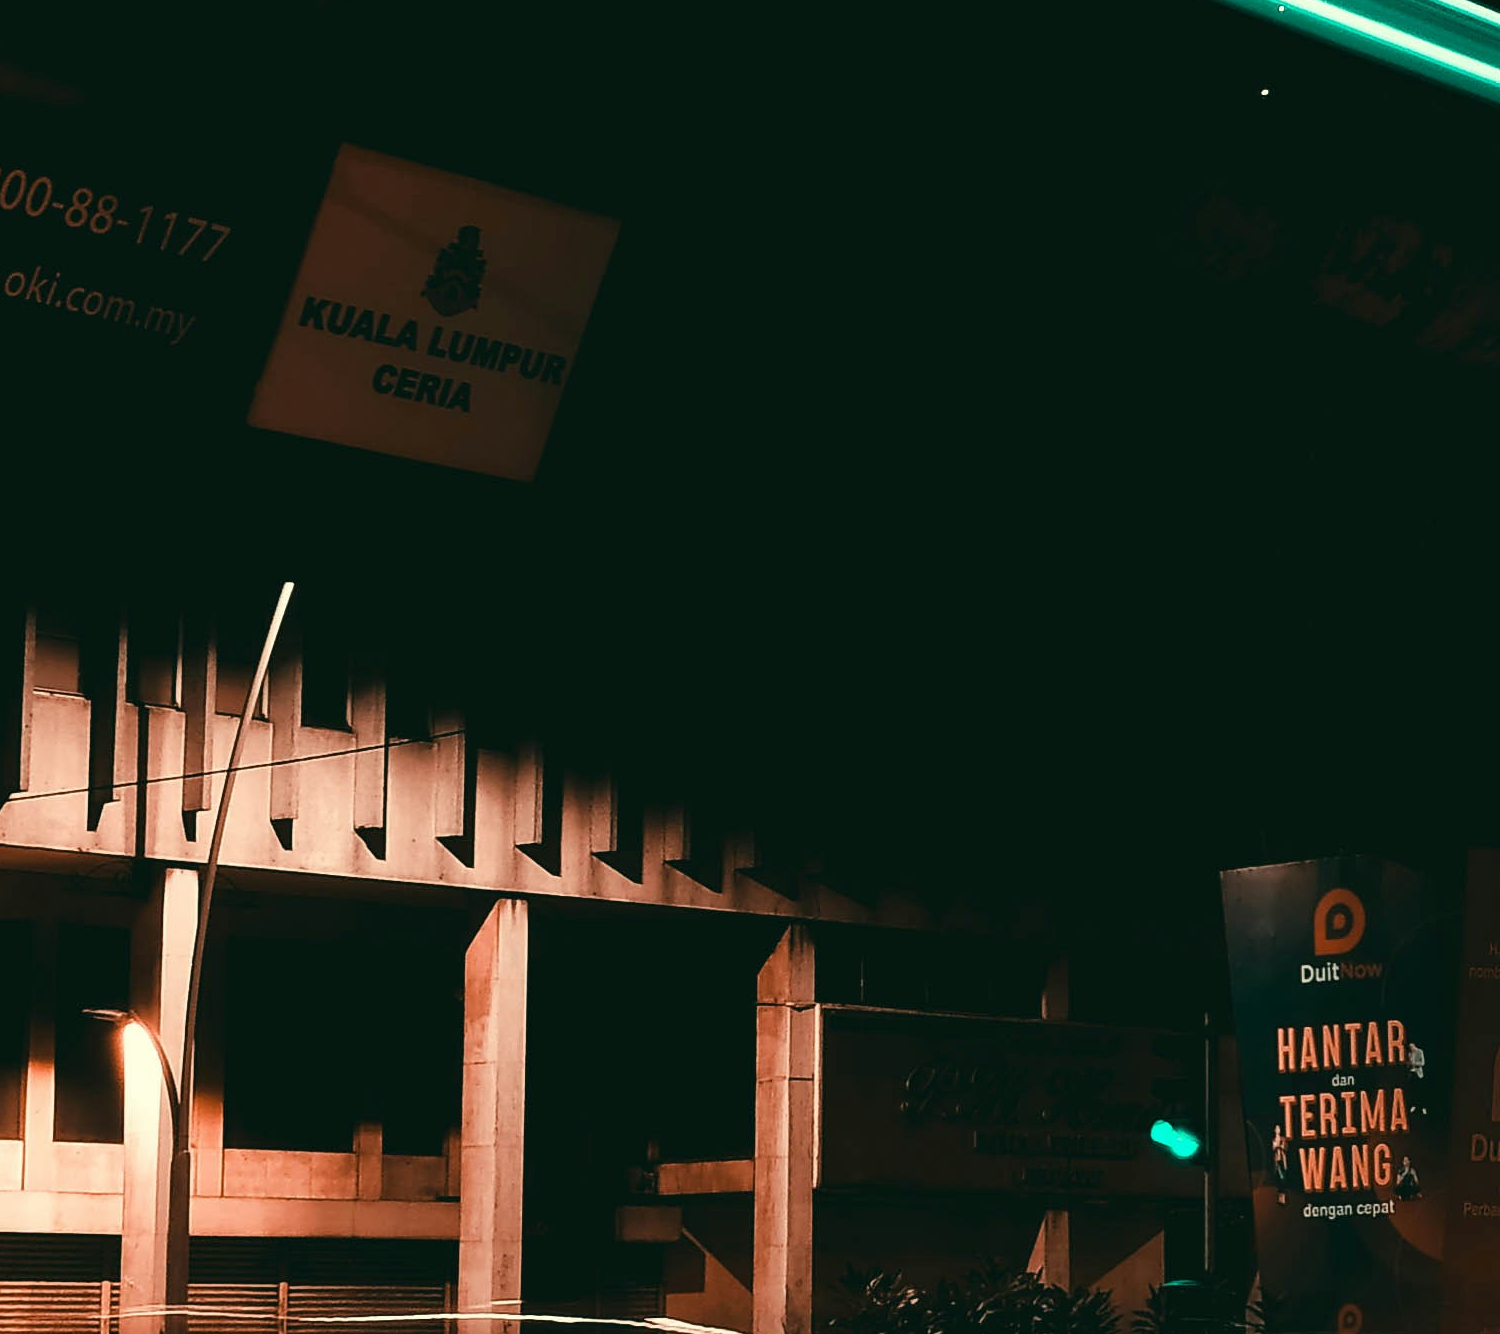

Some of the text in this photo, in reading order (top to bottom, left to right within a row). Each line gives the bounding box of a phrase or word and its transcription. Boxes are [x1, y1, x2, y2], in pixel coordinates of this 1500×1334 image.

[298, 296, 567, 385] KUALA LUMPUR
[373, 364, 473, 413] CERIA
[1300, 961, 1383, 984] DuitNow
[1277, 1019, 1408, 1074] HANTAR
[1332, 1073, 1355, 1088] dan
[1278, 1087, 1410, 1141] TERIMA
[1298, 1143, 1394, 1194] WANG
[1303, 1199, 1396, 1220] dengan cepat
